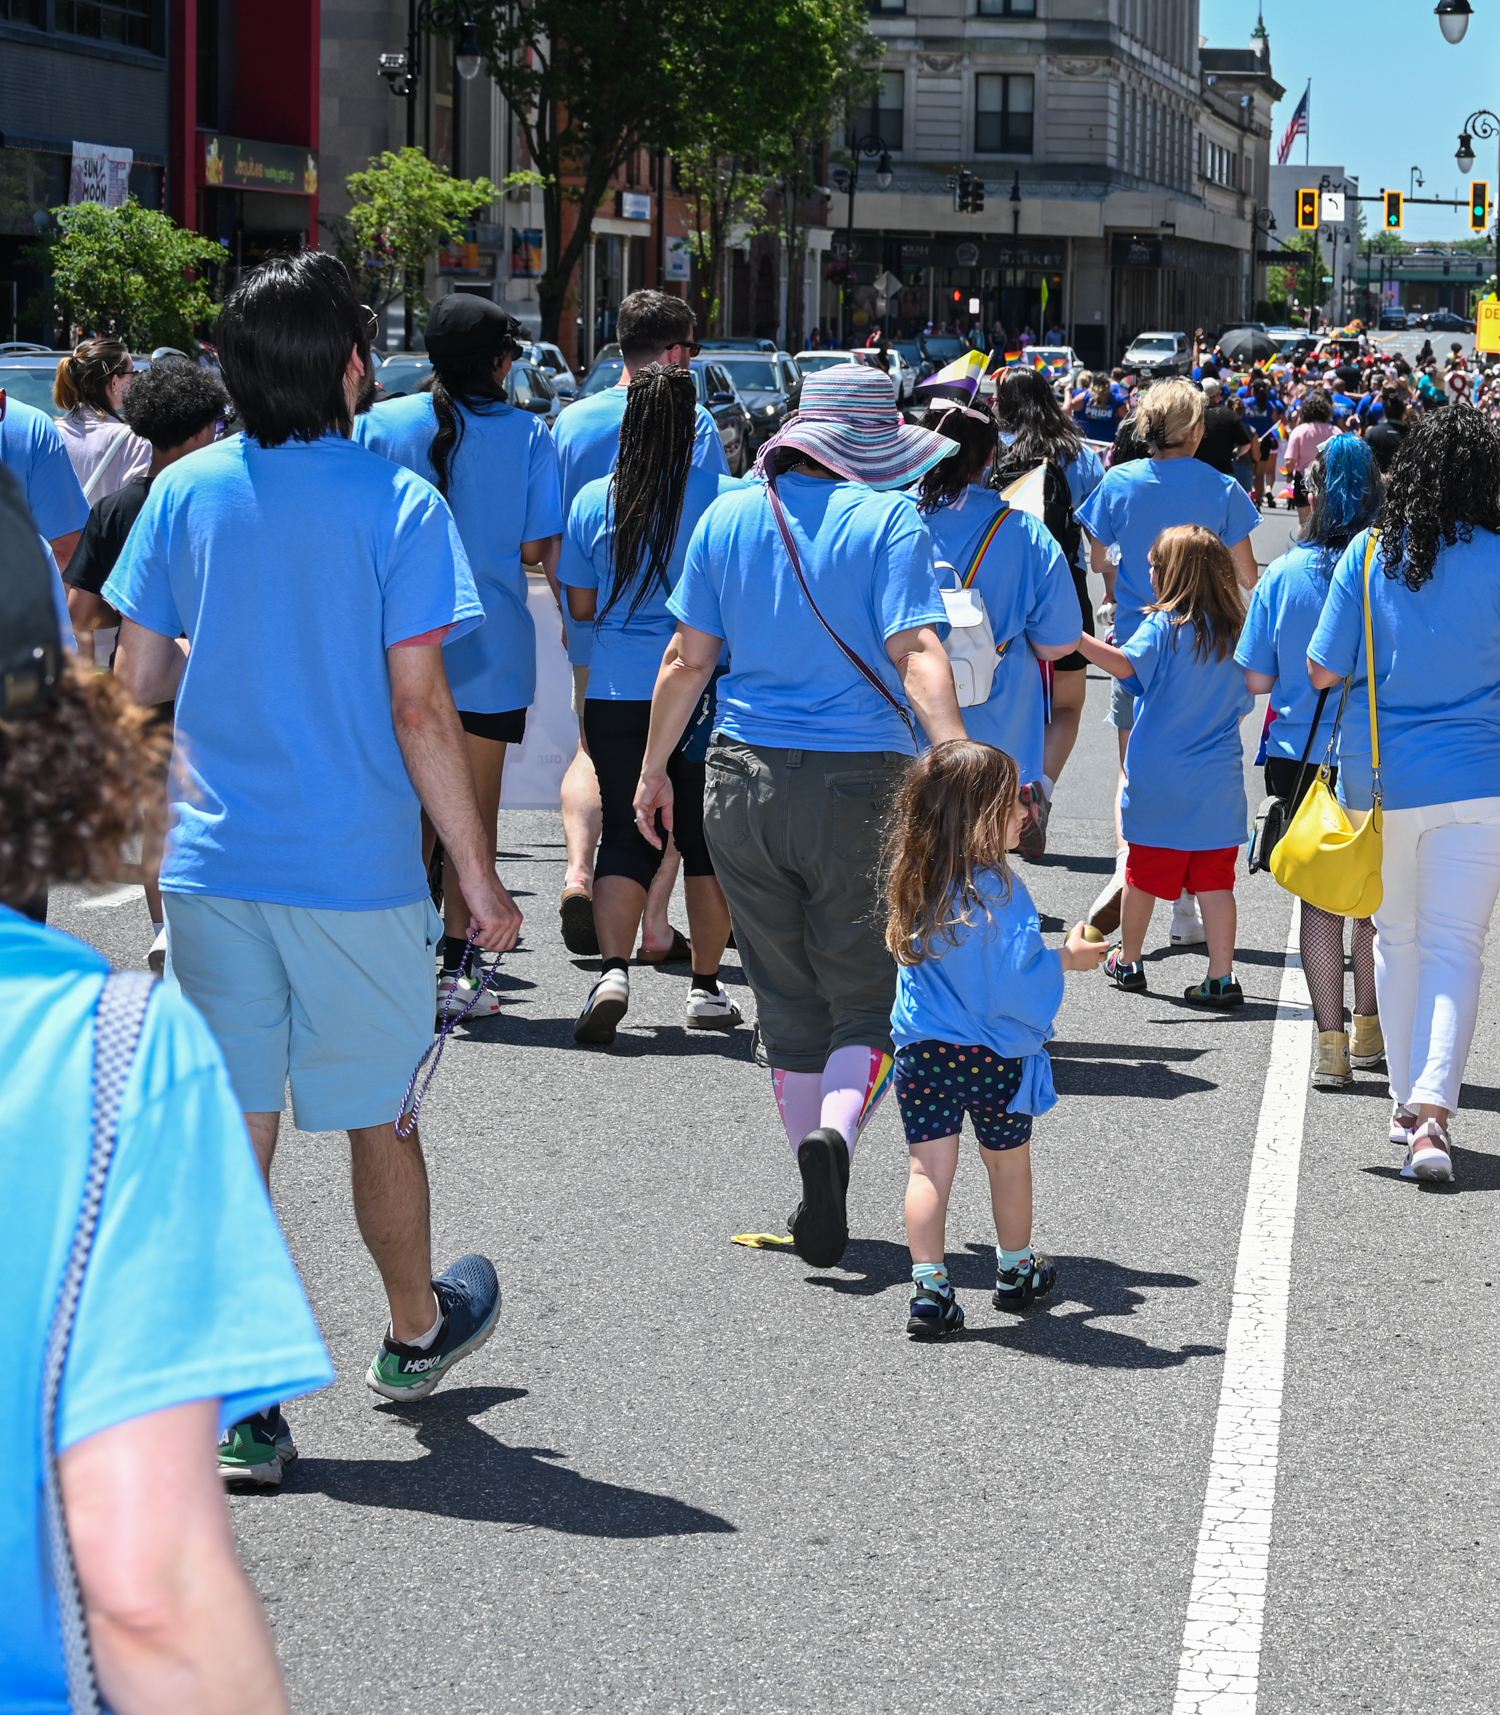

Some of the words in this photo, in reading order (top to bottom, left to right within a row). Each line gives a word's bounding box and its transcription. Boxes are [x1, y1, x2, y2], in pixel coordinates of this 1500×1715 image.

[84, 159, 98, 178] SUN
[83, 183, 107, 203] MOON
[1085, 407, 1112, 418] PRIDE
[403, 1354, 441, 1373] HOKA
